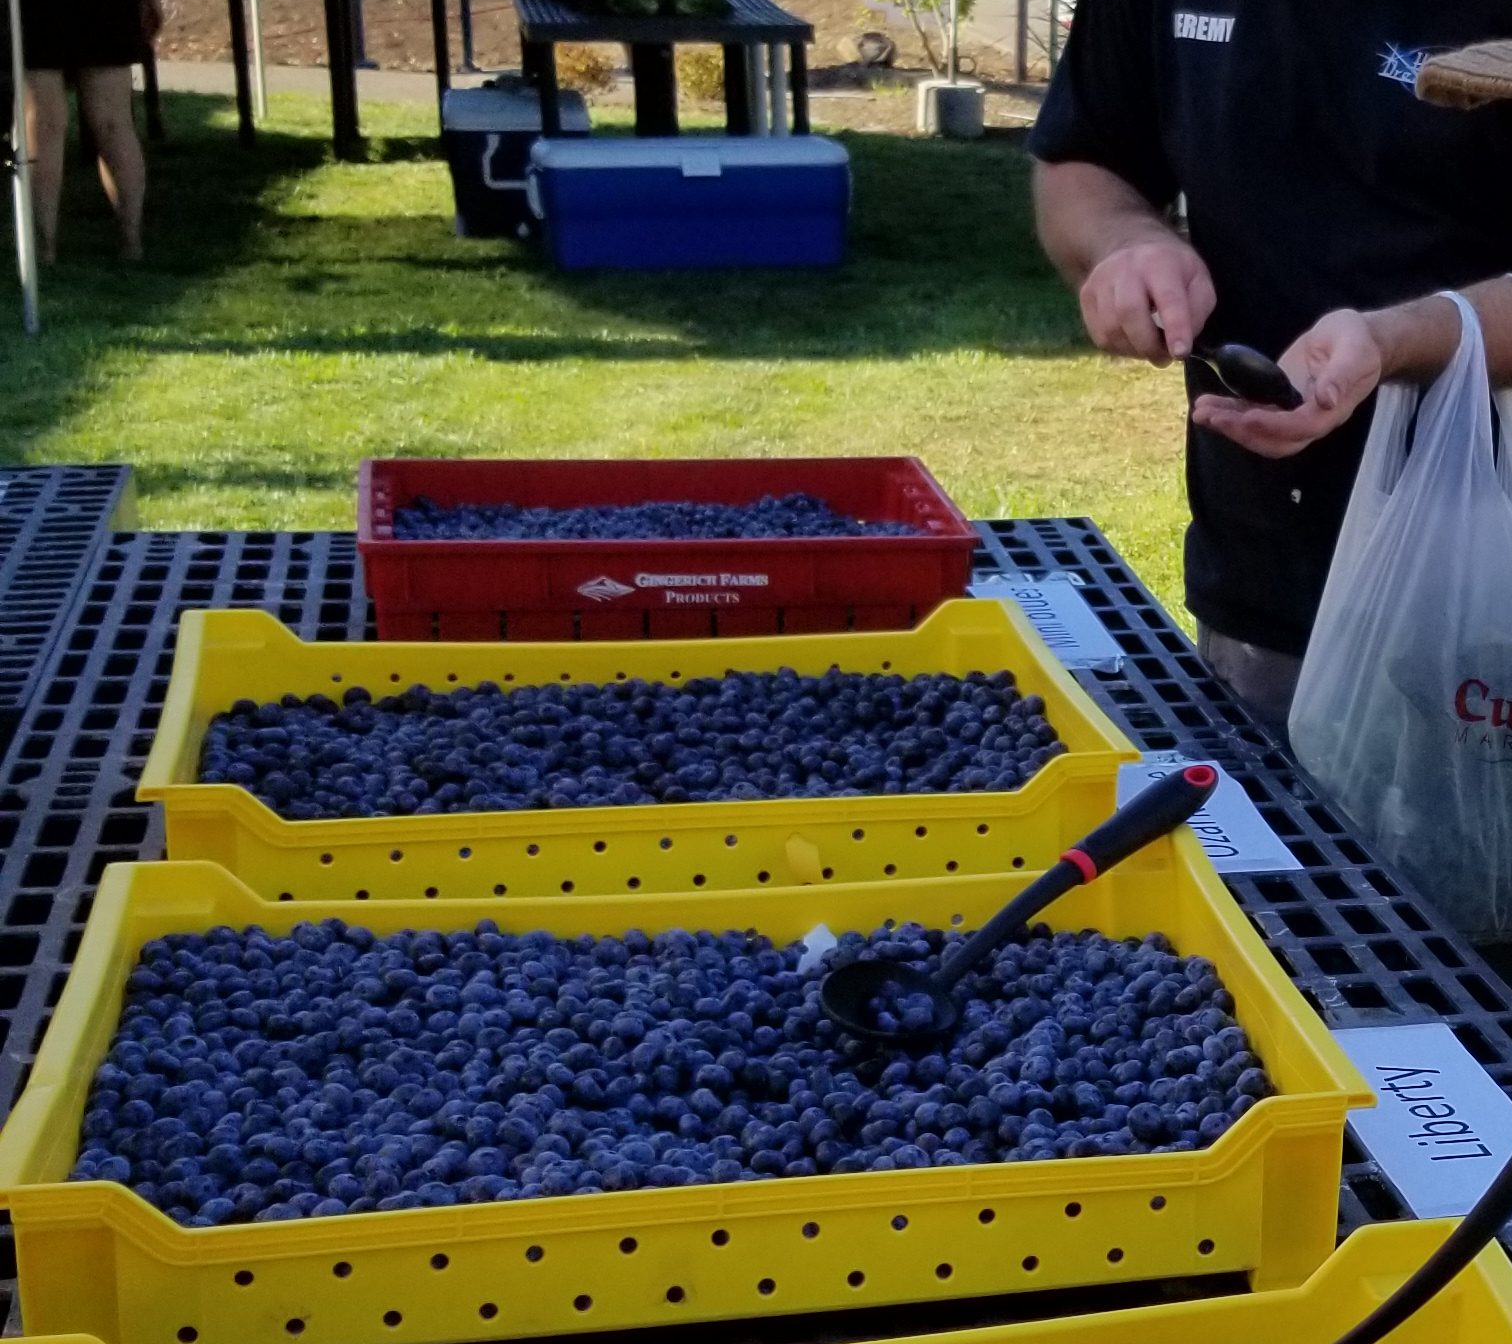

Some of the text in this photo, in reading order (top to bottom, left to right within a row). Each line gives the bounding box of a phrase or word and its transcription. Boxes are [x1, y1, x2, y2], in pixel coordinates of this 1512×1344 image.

[1173, 13, 1236, 43] EREMY
[720, 573, 769, 587] FARMS
[665, 590, 740, 604] PRODUCTS
[1376, 1066, 1492, 1160] Liberty
